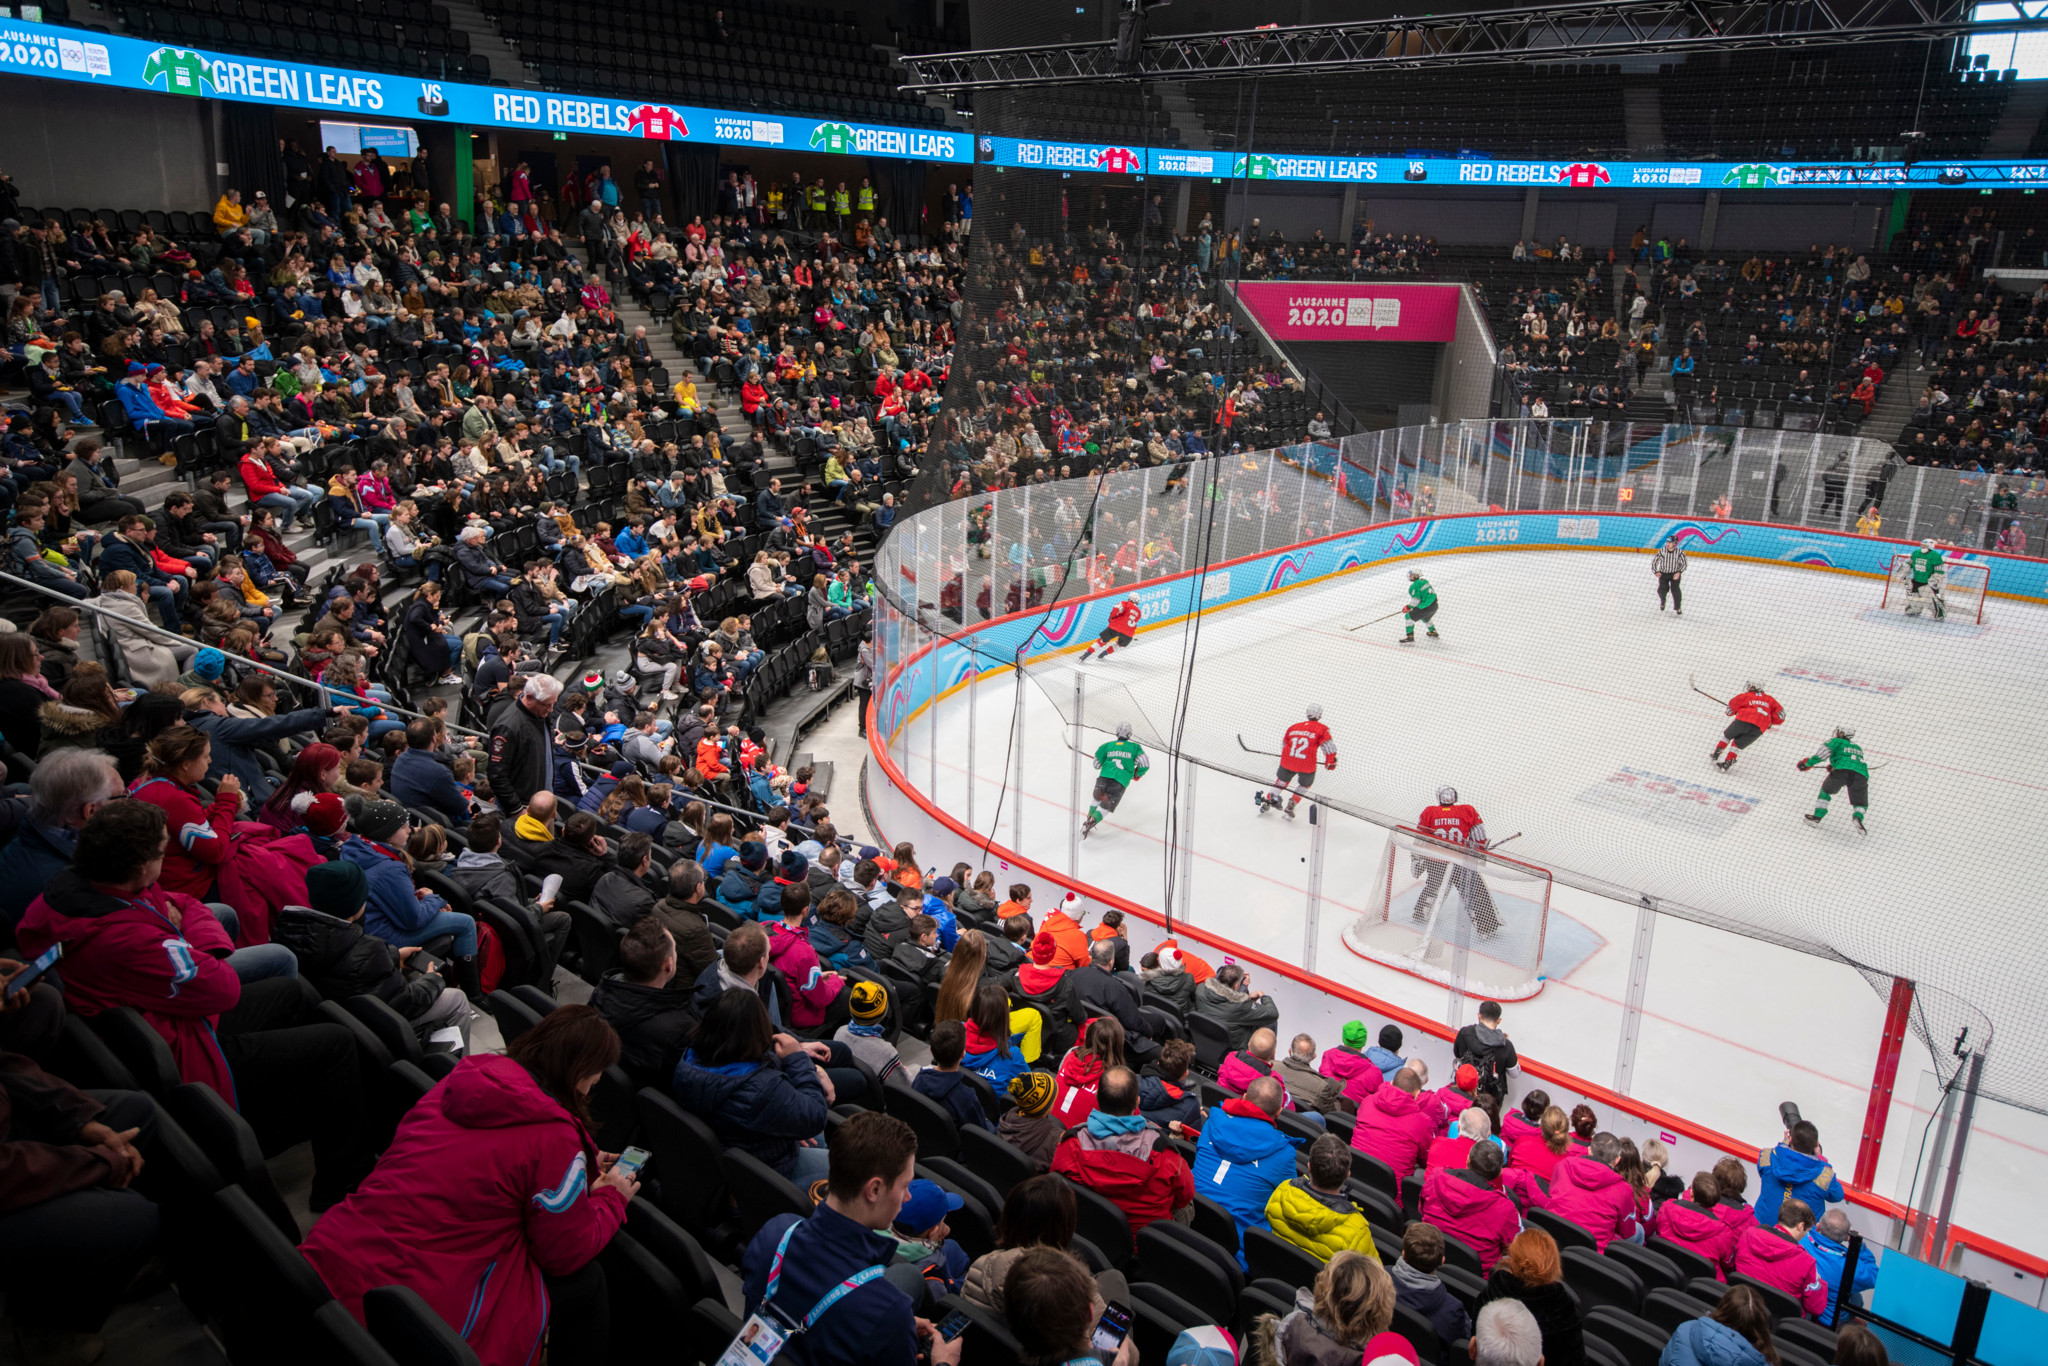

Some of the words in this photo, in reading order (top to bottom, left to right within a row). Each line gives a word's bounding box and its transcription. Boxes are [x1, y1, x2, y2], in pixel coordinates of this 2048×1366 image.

[0, 42, 58, 68] 2020
[212, 60, 300, 101] GREEN
[305, 72, 384, 110] LEAFS
[421, 83, 443, 104] VS
[493, 93, 540, 123] RED
[547, 99, 630, 132] REBELS
[714, 117, 751, 127] LAUSANNE
[715, 125, 752, 140] 2020
[856, 128, 906, 154] GREEN
[910, 134, 955, 158] LEAFS
[1017, 143, 1043, 164] RED
[1046, 145, 1099, 168] REBELS
[1158, 160, 1186, 172] 2020
[1276, 158, 1326, 178] GREEN
[1329, 161, 1377, 180] LEAFS
[1409, 161, 1424, 174] VS
[1459, 163, 1492, 181] RED
[1496, 164, 1561, 183] REBELS
[1632, 173, 1668, 184] 2020
[1289, 297, 1345, 307] LAUSANNE
[1288, 308, 1345, 326] 2020
[1618, 488, 1633, 501] 30
[1477, 519, 1520, 529] LAUSANNE
[1476, 528, 1519, 542] 2020
[1141, 598, 1171, 620] 020
[1290, 737, 1309, 760] 12
[812, 1289, 841, 1318] SAMSUNG
